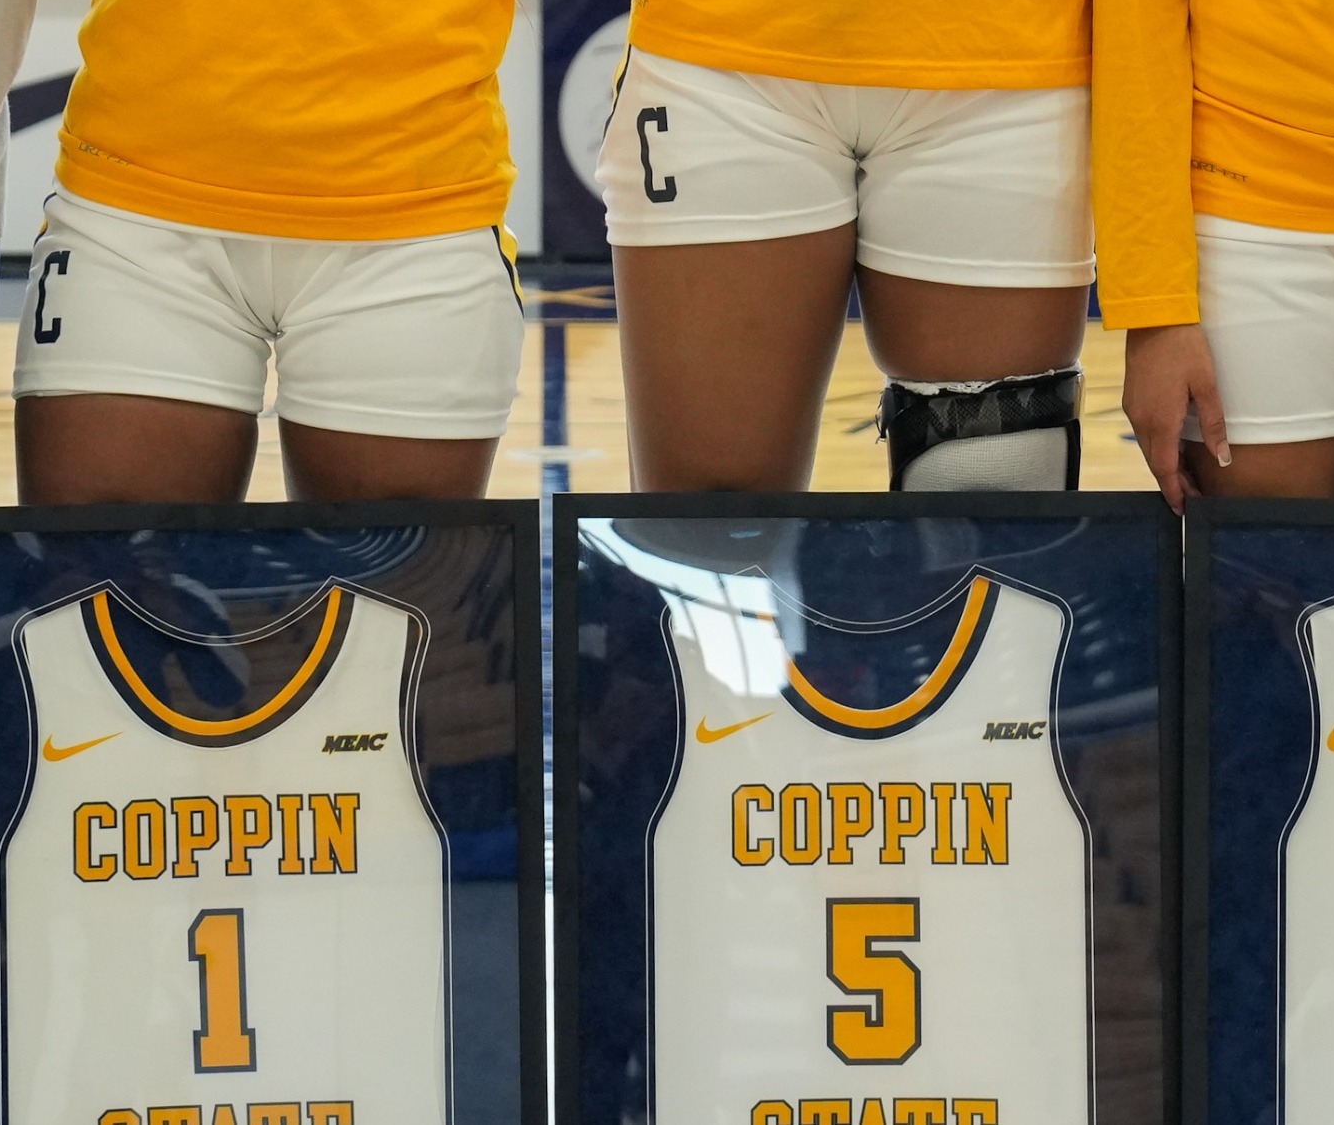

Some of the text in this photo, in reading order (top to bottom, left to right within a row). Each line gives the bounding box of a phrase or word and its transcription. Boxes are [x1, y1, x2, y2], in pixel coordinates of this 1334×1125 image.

[636, 106, 678, 204] C
[33, 250, 71, 345] C
[321, 732, 389, 755] MEAC
[982, 720, 1047, 743] MEAC
[73, 792, 361, 883] COPPIN
[731, 782, 1013, 867] COPPIN
[187, 907, 258, 1075] 1
[825, 896, 922, 1066] 5
